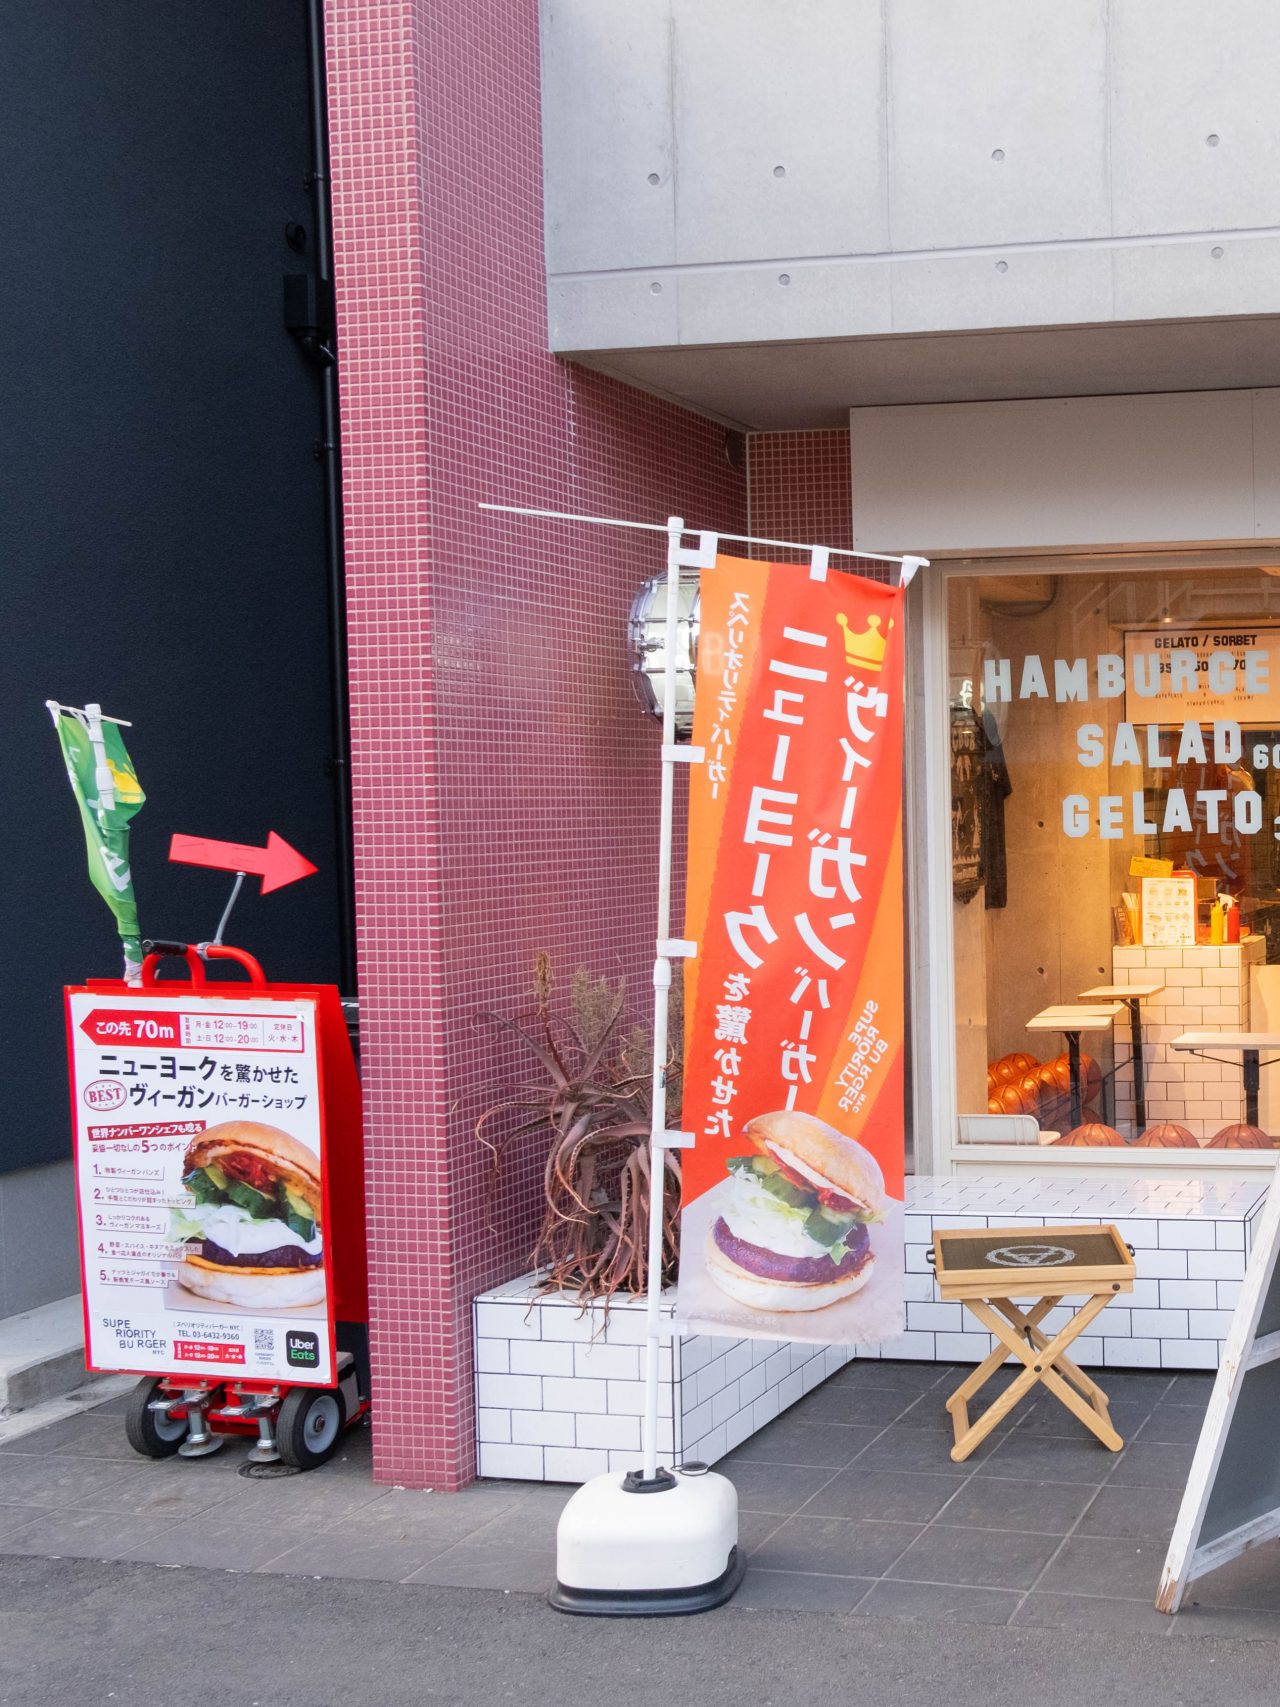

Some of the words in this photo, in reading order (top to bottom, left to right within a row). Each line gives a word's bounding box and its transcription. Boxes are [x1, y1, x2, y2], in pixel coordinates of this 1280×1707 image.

[1155, 636, 1199, 649] GELATO
[1213, 634, 1257, 647] SORBET
[1076, 720, 1243, 768] SALAD
[1062, 789, 1263, 839] GELATO
[99, 1055, 299, 1085] ニューヨークを驚かせた
[89, 1087, 122, 1103] BEST
[103, 1318, 131, 1329] SUPE
[115, 1328, 156, 1339] RIORITY
[290, 1338, 315, 1349] Uber
[291, 1349, 315, 1361] Eats
